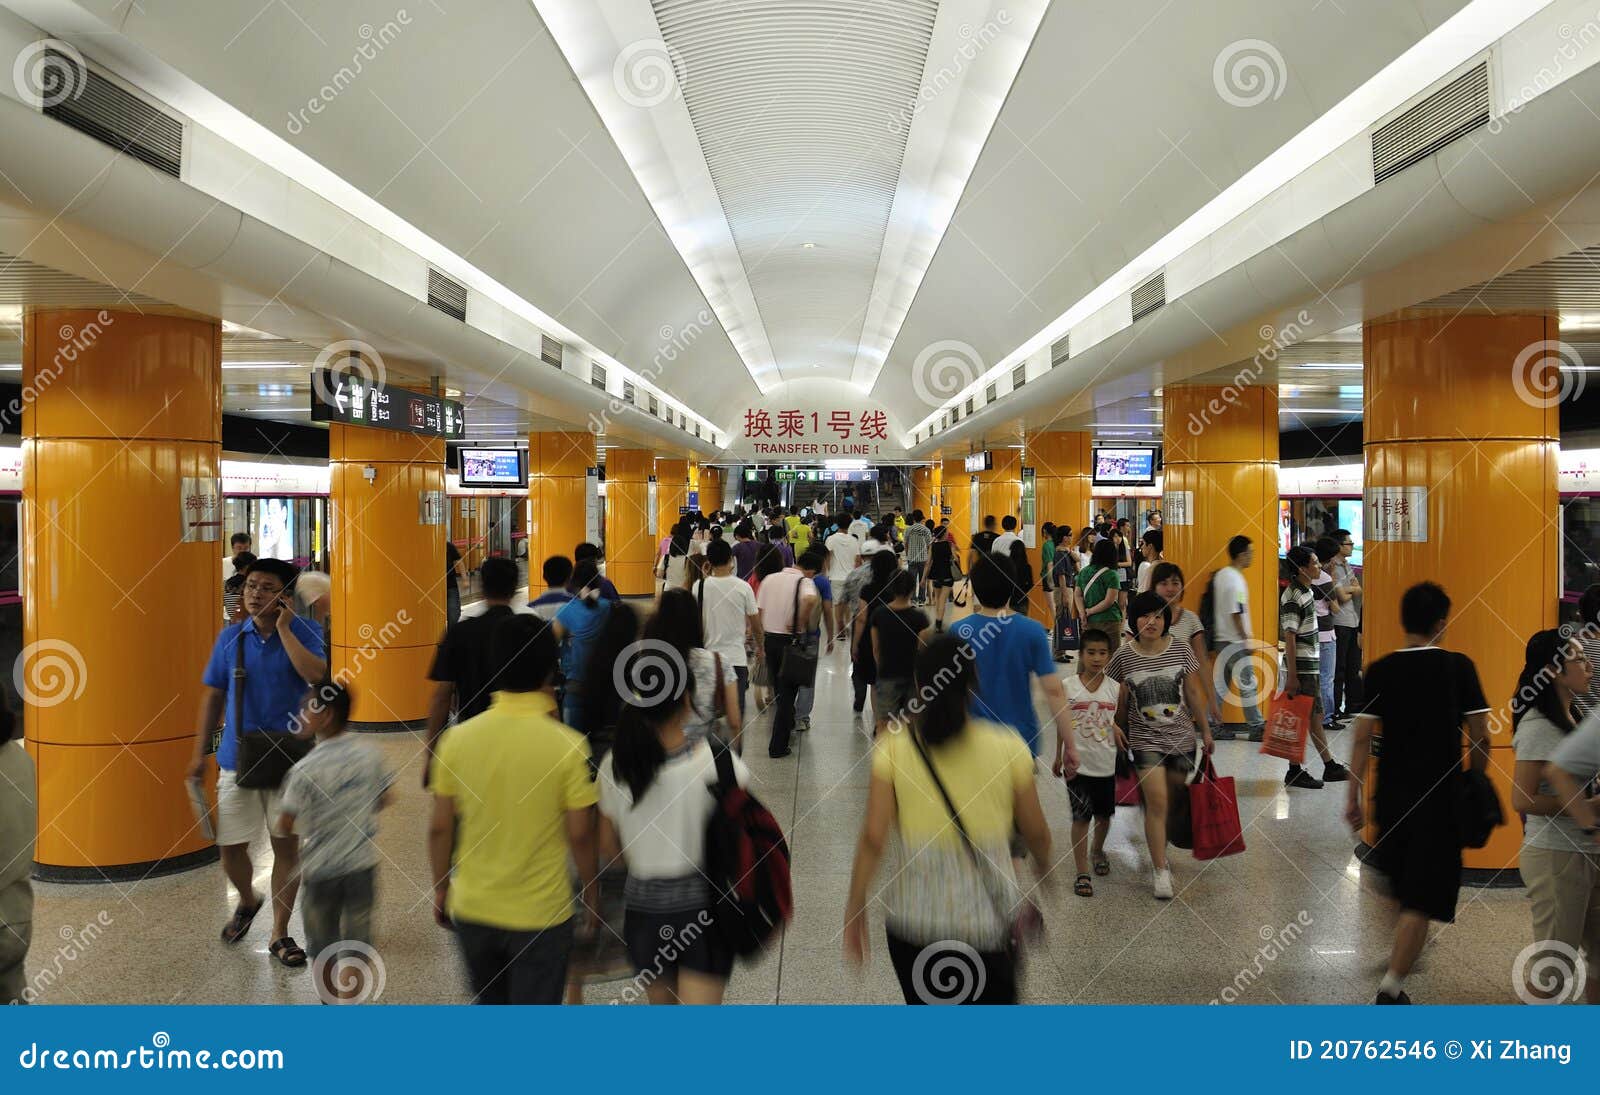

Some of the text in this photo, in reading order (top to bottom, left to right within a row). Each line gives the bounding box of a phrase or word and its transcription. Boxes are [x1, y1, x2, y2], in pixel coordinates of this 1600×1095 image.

[744, 408, 888, 440] 换乘1号线
[754, 443, 880, 455] TRANSFER TO LINE 1
